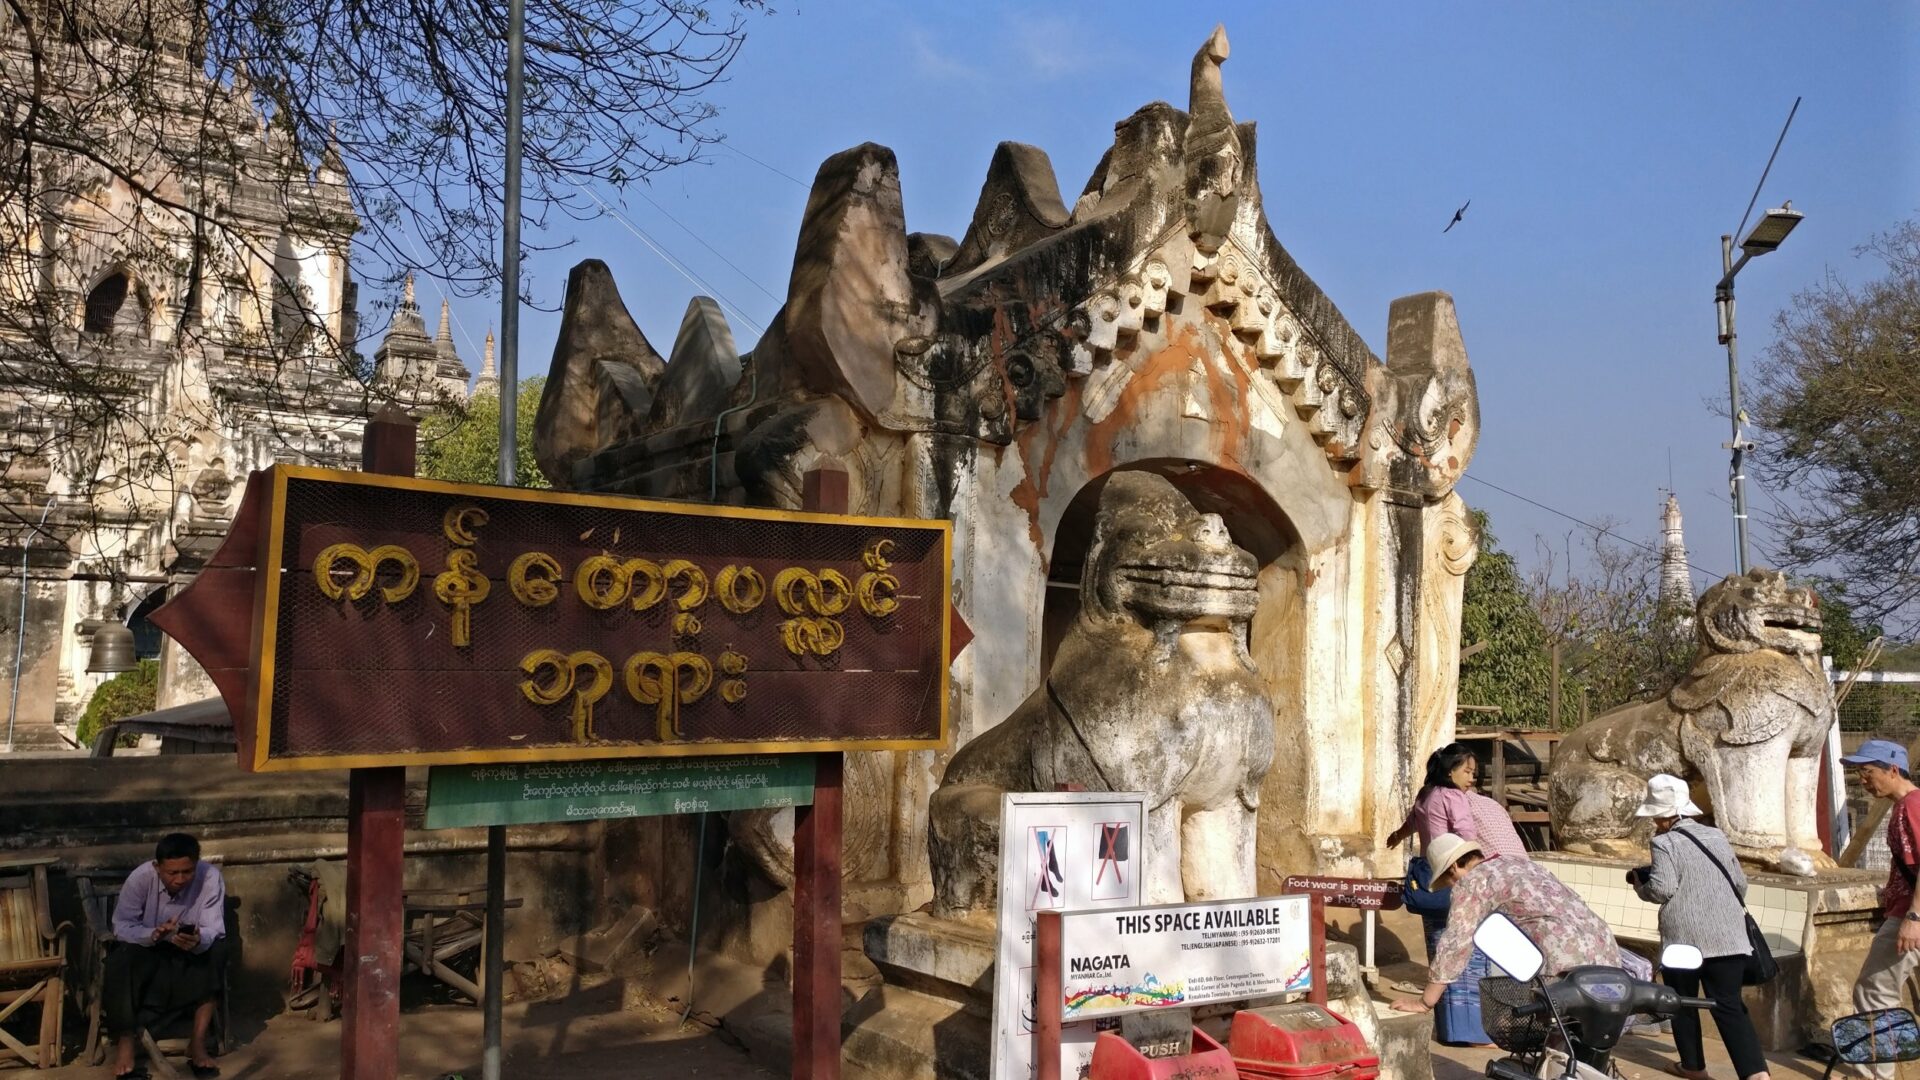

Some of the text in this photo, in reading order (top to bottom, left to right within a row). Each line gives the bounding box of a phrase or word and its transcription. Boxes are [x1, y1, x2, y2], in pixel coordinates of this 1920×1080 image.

[518, 642, 749, 743] ဘုရား
[1341, 880, 1349, 890] is
[1353, 881, 1399, 894] prohibited
[1116, 907, 1280, 935] THIS SPACE AVAILABLE
[1070, 954, 1130, 972] NAGATA
[1201, 983, 1215, 991] Corner
[1230, 981, 1245, 989] Pagoda
[1139, 1041, 1181, 1057] PUSH
